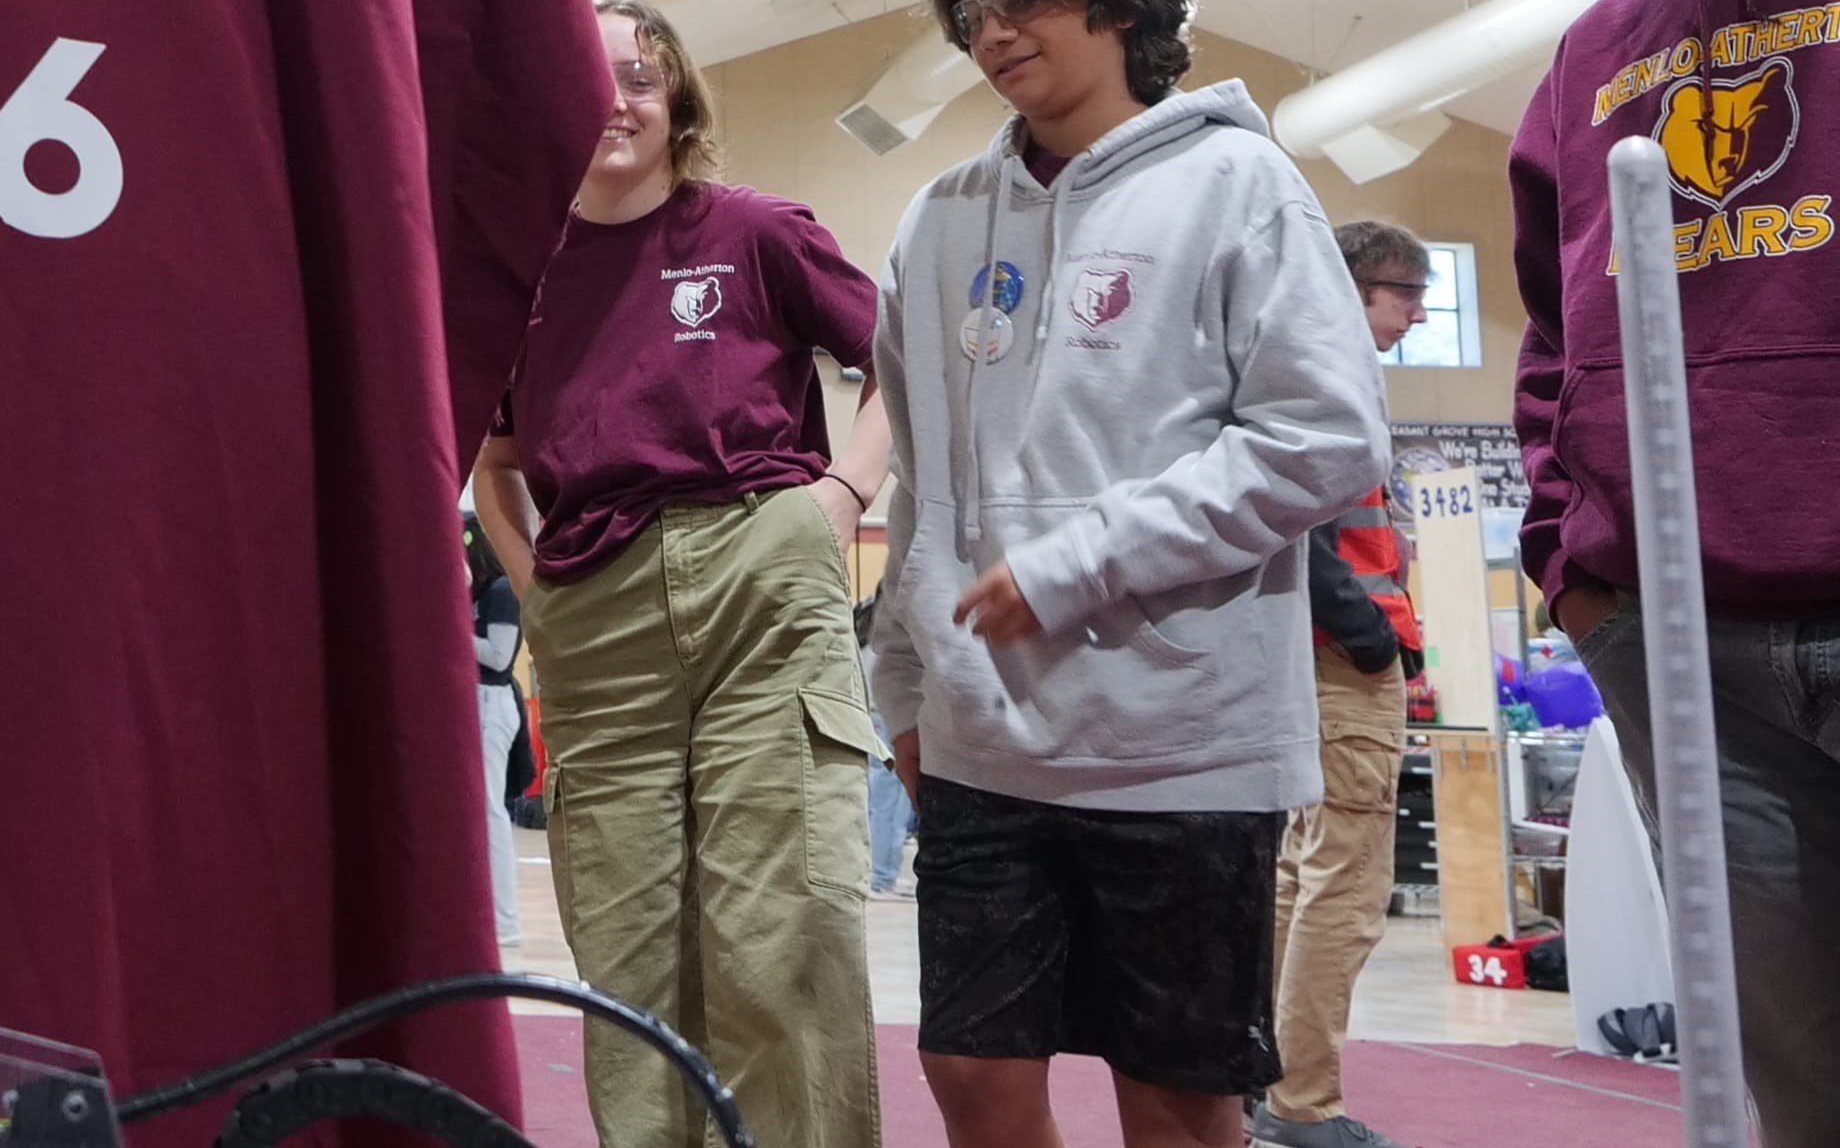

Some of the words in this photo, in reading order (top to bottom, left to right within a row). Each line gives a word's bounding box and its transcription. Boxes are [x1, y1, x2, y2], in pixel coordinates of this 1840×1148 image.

[1606, 194, 1835, 277] EARS
[660, 263, 735, 281] Menlo-Atherton
[674, 329, 716, 344] Robotics
[1420, 484, 1473, 517] 3482
[1467, 953, 1508, 986] 34
